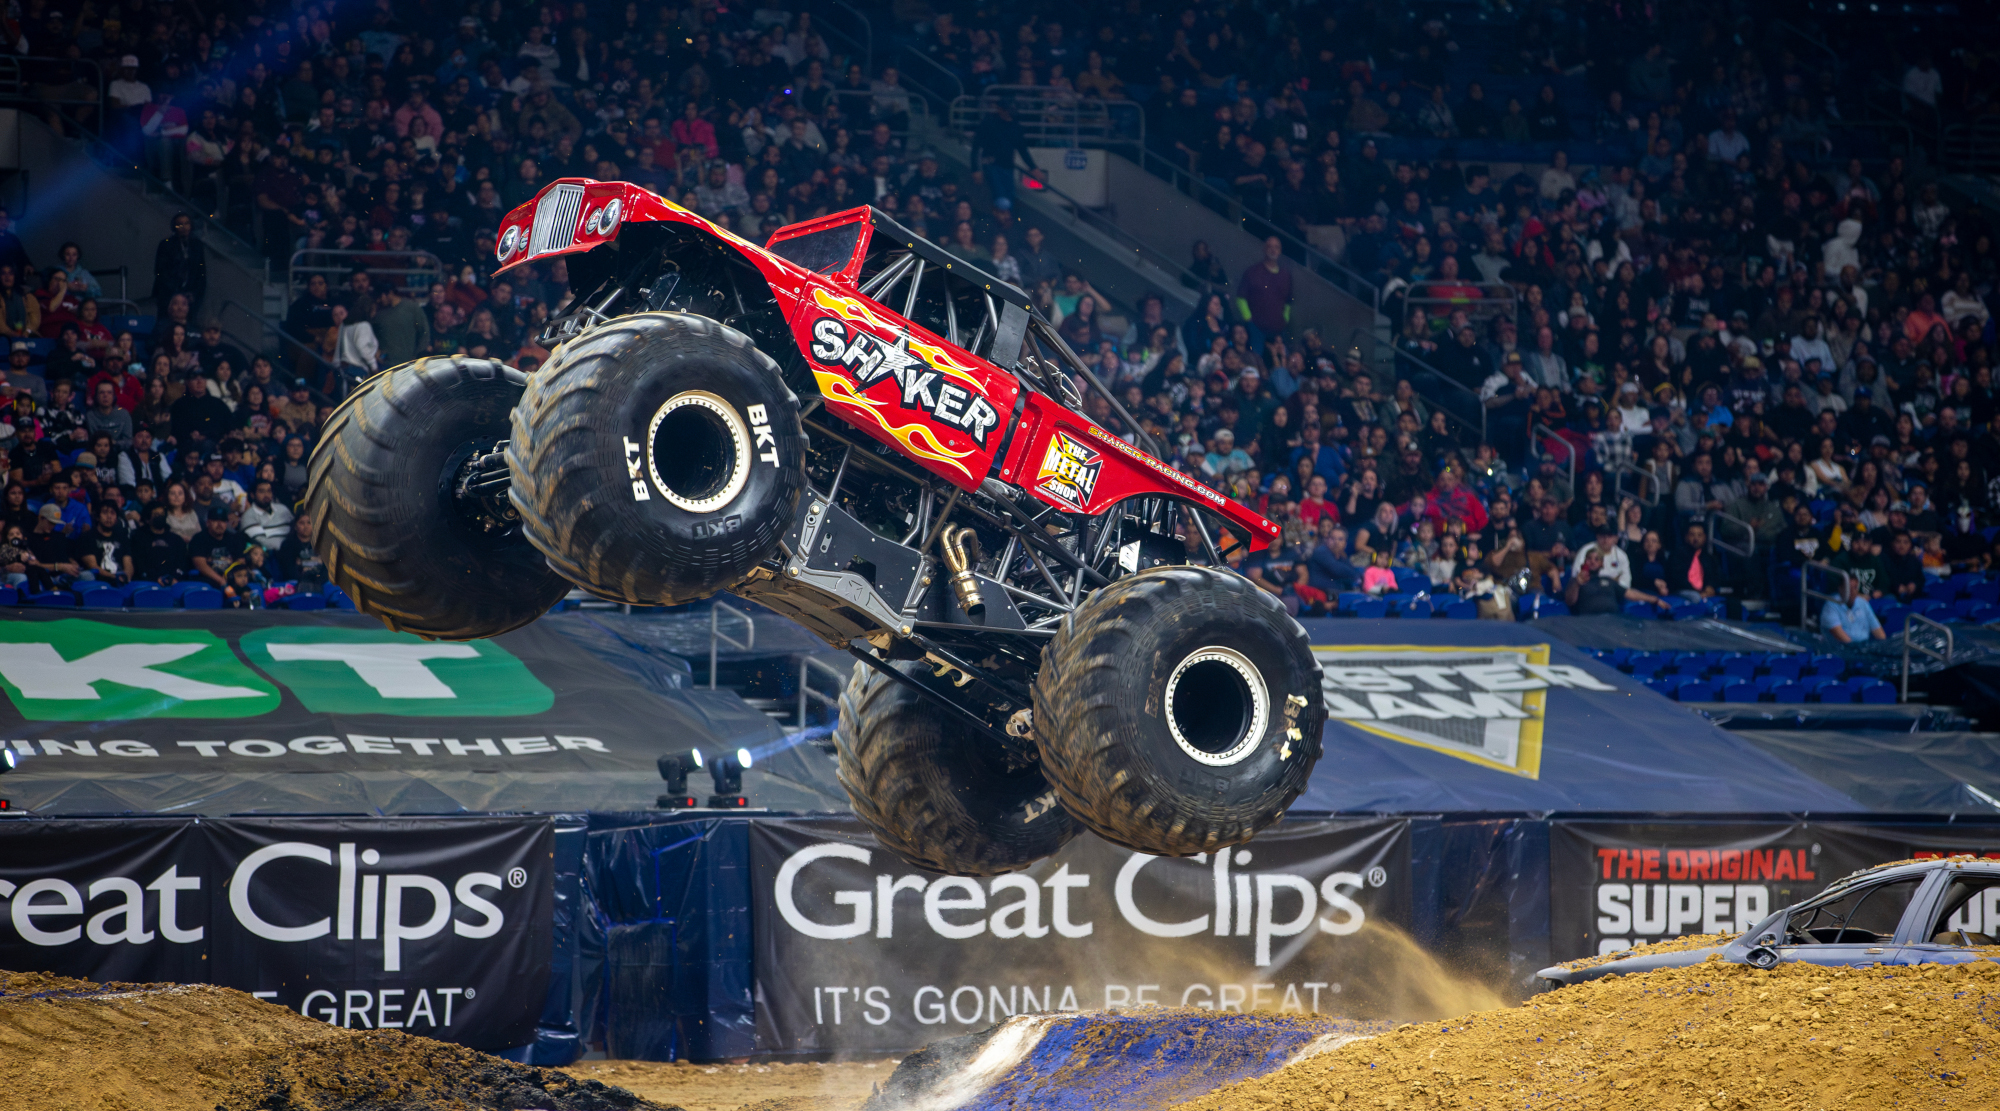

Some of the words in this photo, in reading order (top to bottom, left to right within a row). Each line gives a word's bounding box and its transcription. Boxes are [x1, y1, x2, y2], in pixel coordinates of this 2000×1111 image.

[747, 403, 780, 468] BKT
[1067, 441, 1088, 460] THE
[623, 436, 650, 501] BKT
[1043, 446, 1096, 495] METAL
[1088, 426, 1226, 506] SHAKER-RACING.COM
[1048, 479, 1077, 501] SHOP
[692, 517, 742, 542] BKT
[1321, 664, 1617, 692] STER
[177, 734, 612, 757] TOGETHER
[1598, 848, 1661, 880] THE
[774, 842, 1093, 940] Great
[1597, 883, 1769, 935] SUPER
[814, 986, 891, 1025] IT'S
[912, 985, 1080, 1024] GONNA
